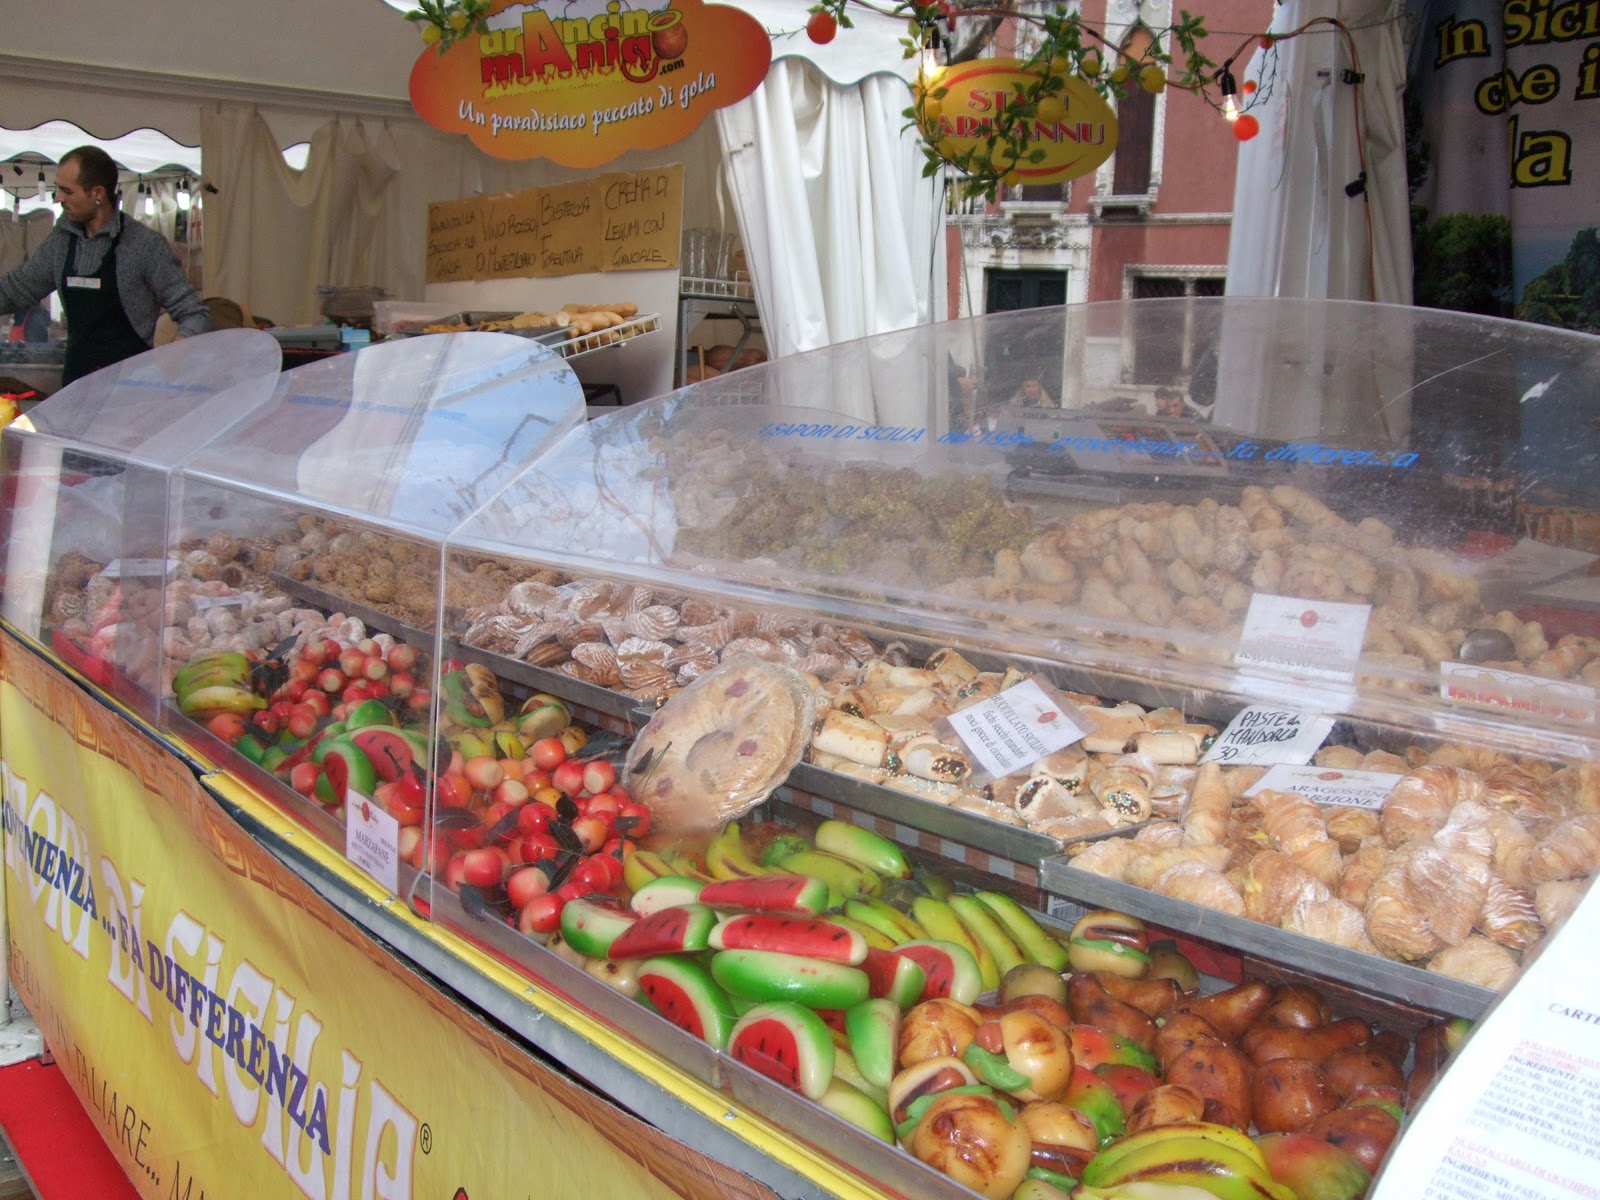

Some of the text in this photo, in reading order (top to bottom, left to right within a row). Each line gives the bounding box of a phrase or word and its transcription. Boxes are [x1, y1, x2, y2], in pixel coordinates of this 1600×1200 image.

[458, 72, 716, 136] Un paradisiaco peccato di gola
[767, 423, 833, 439] SAPORI
[833, 425, 856, 440] DI
[857, 426, 927, 443] SICILIA
[1239, 711, 1289, 728] PASTE
[147, 939, 332, 1156] DIFFERENZA
